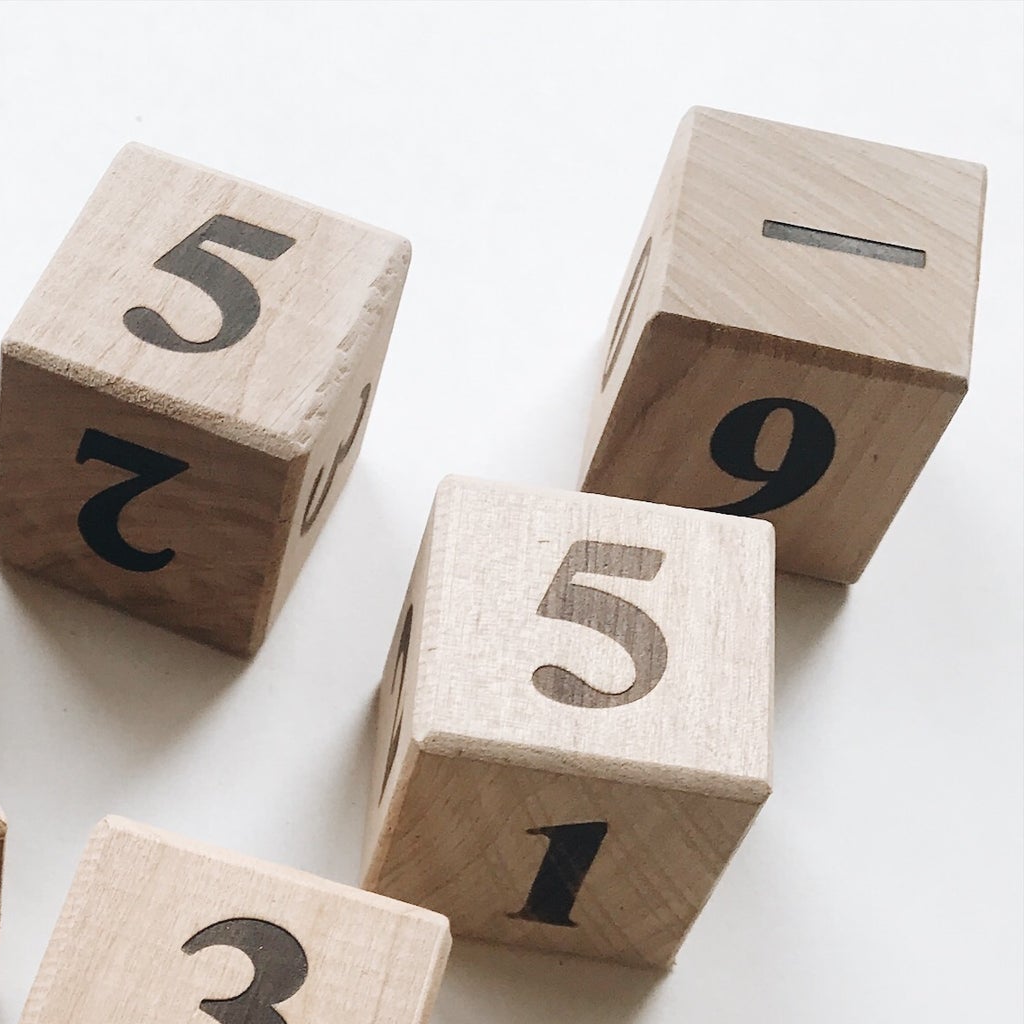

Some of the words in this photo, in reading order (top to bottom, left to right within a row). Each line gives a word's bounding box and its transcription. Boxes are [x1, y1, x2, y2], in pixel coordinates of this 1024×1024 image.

[122, 213, 296, 353] 5
[76, 427, 190, 573] 2
[703, 397, 837, 518] 9
[531, 539, 668, 709] 5
[503, 820, 608, 928] 1
